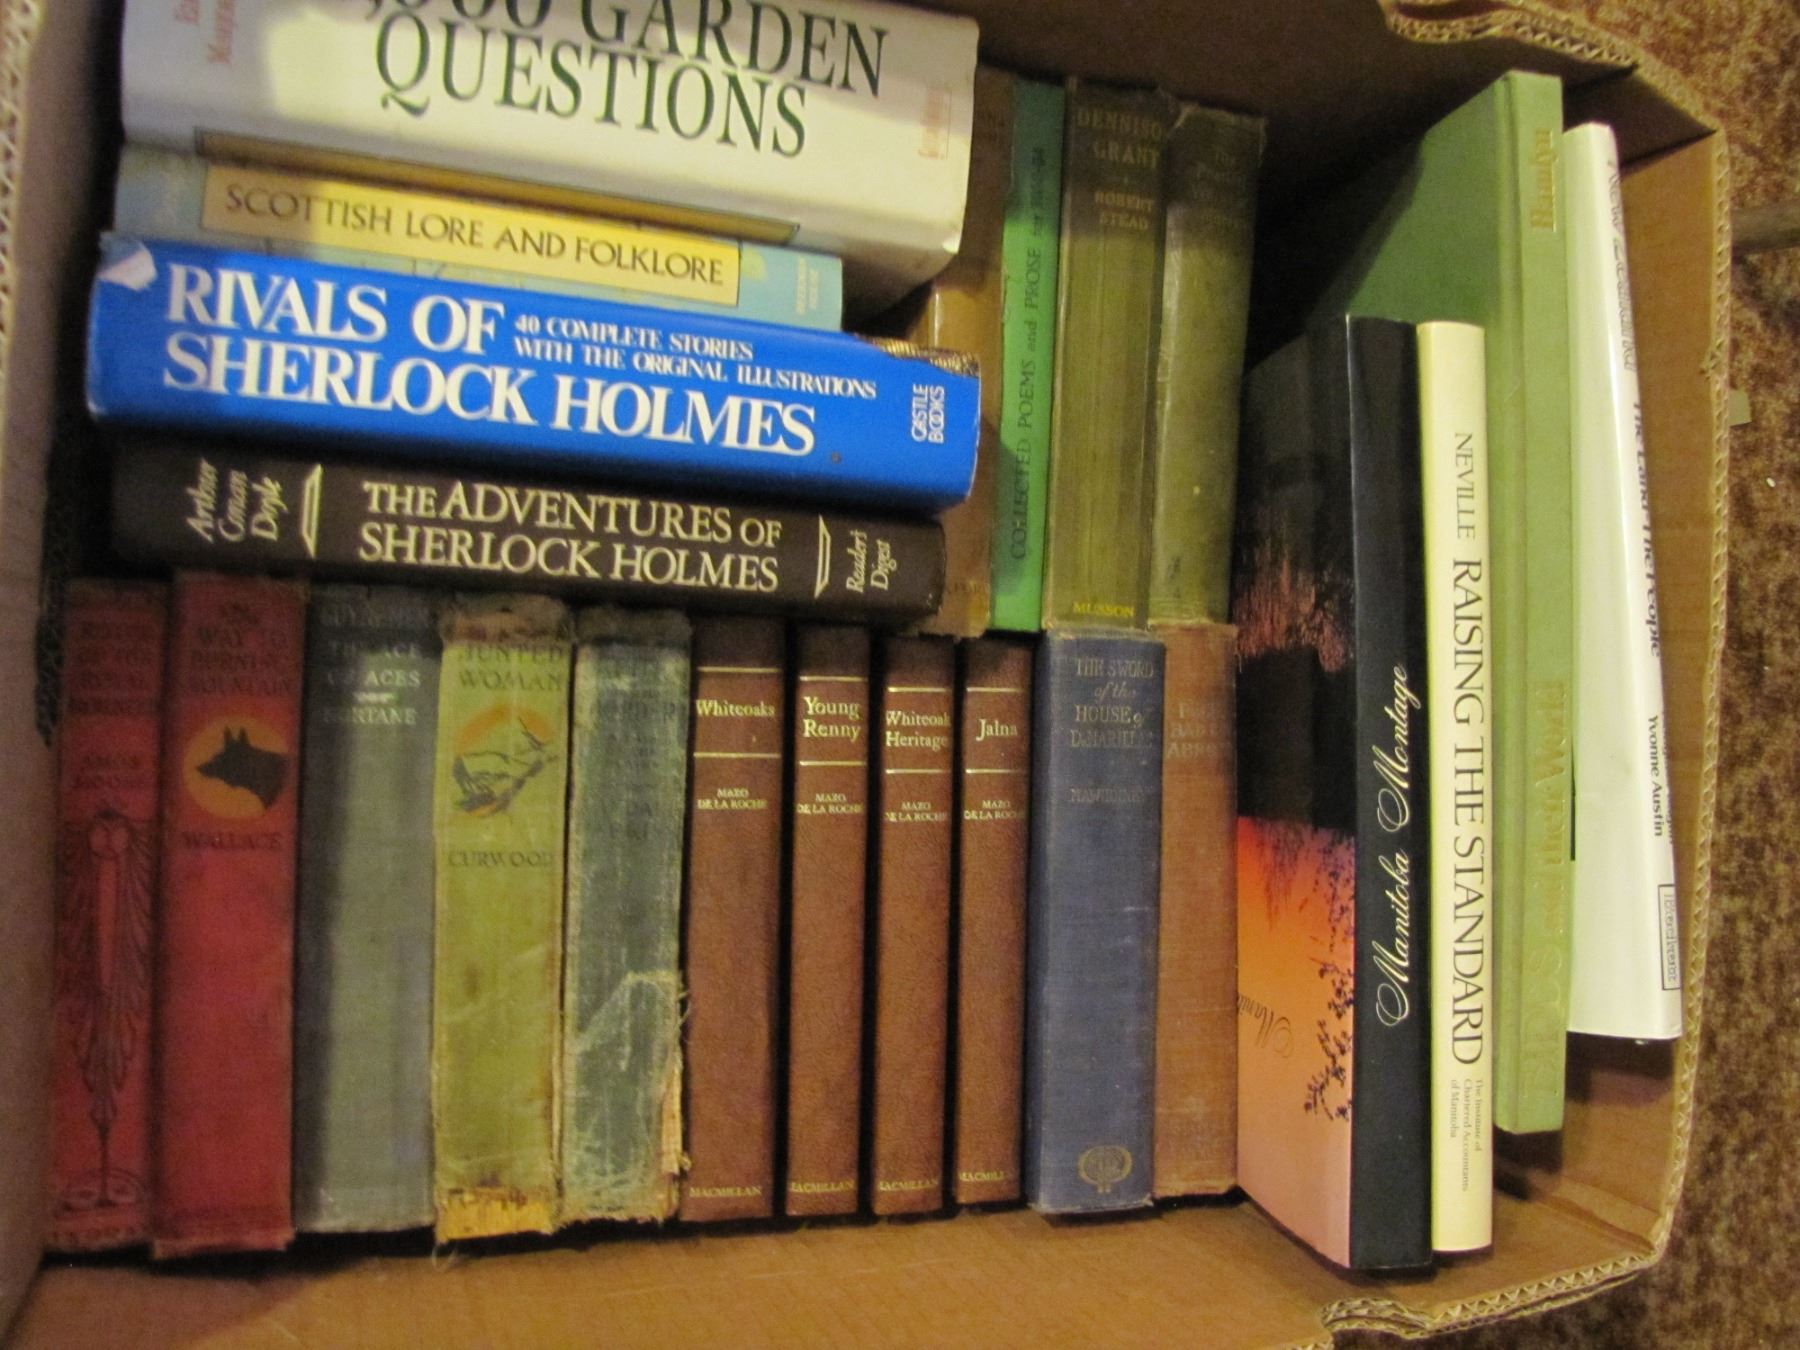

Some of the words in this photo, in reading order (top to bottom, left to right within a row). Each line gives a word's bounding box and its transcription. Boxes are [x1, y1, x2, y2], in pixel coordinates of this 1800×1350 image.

[581, 0, 890, 99] GARDEN
[376, 11, 807, 158] QUESTIONS
[226, 183, 393, 233] SCOTTISH
[405, 209, 484, 248] LORE
[493, 226, 567, 260] AND
[575, 238, 724, 286] FOLKLORE
[165, 262, 388, 342] RIVALS
[412, 294, 505, 355] OF
[1024, 248, 1042, 309] PROSE
[513, 313, 541, 334] 40
[546, 316, 663, 352] COMPLETE
[669, 332, 755, 361] STORIES
[513, 336, 573, 364] WITH
[582, 344, 626, 370] THE
[632, 350, 728, 383] ORIGINAL
[736, 364, 877, 400] ILLUSTRATIONS
[163, 331, 539, 427] SHERLOCK
[550, 373, 816, 457] HOLMES
[910, 383, 929, 442] CASTLE
[928, 384, 946, 444] BOOKS
[1017, 359, 1037, 429] POEMS
[186, 457, 220, 543] Arthur
[218, 470, 248, 542] Conan
[250, 476, 289, 542] Doyle
[361, 480, 438, 519] THE
[441, 480, 732, 544] ADVENTURES
[739, 517, 783, 549] OF
[1010, 439, 1032, 561] COLLECTED
[1455, 432, 1476, 539] NEVILLE
[357, 522, 602, 580] SHERLOCK
[608, 542, 780, 593] HOLMES
[1453, 558, 1484, 725] RAISING
[457, 669, 565, 692] WOMAN
[694, 698, 776, 718] Whiteoaks
[803, 695, 862, 721] Young
[1074, 704, 1131, 723] HOUSE
[802, 719, 862, 743] Renny
[885, 729, 948, 752] Heritage
[975, 718, 1019, 742] Jalna
[1371, 665, 1422, 832] Montage
[1648, 715, 1661, 777] Yvonne
[1454, 735, 1485, 826] THE
[1651, 780, 1666, 837] Austin
[447, 849, 553, 869] CURWOOD
[1372, 849, 1411, 1027] Manitoba
[1452, 835, 1485, 1065] STANDARD
